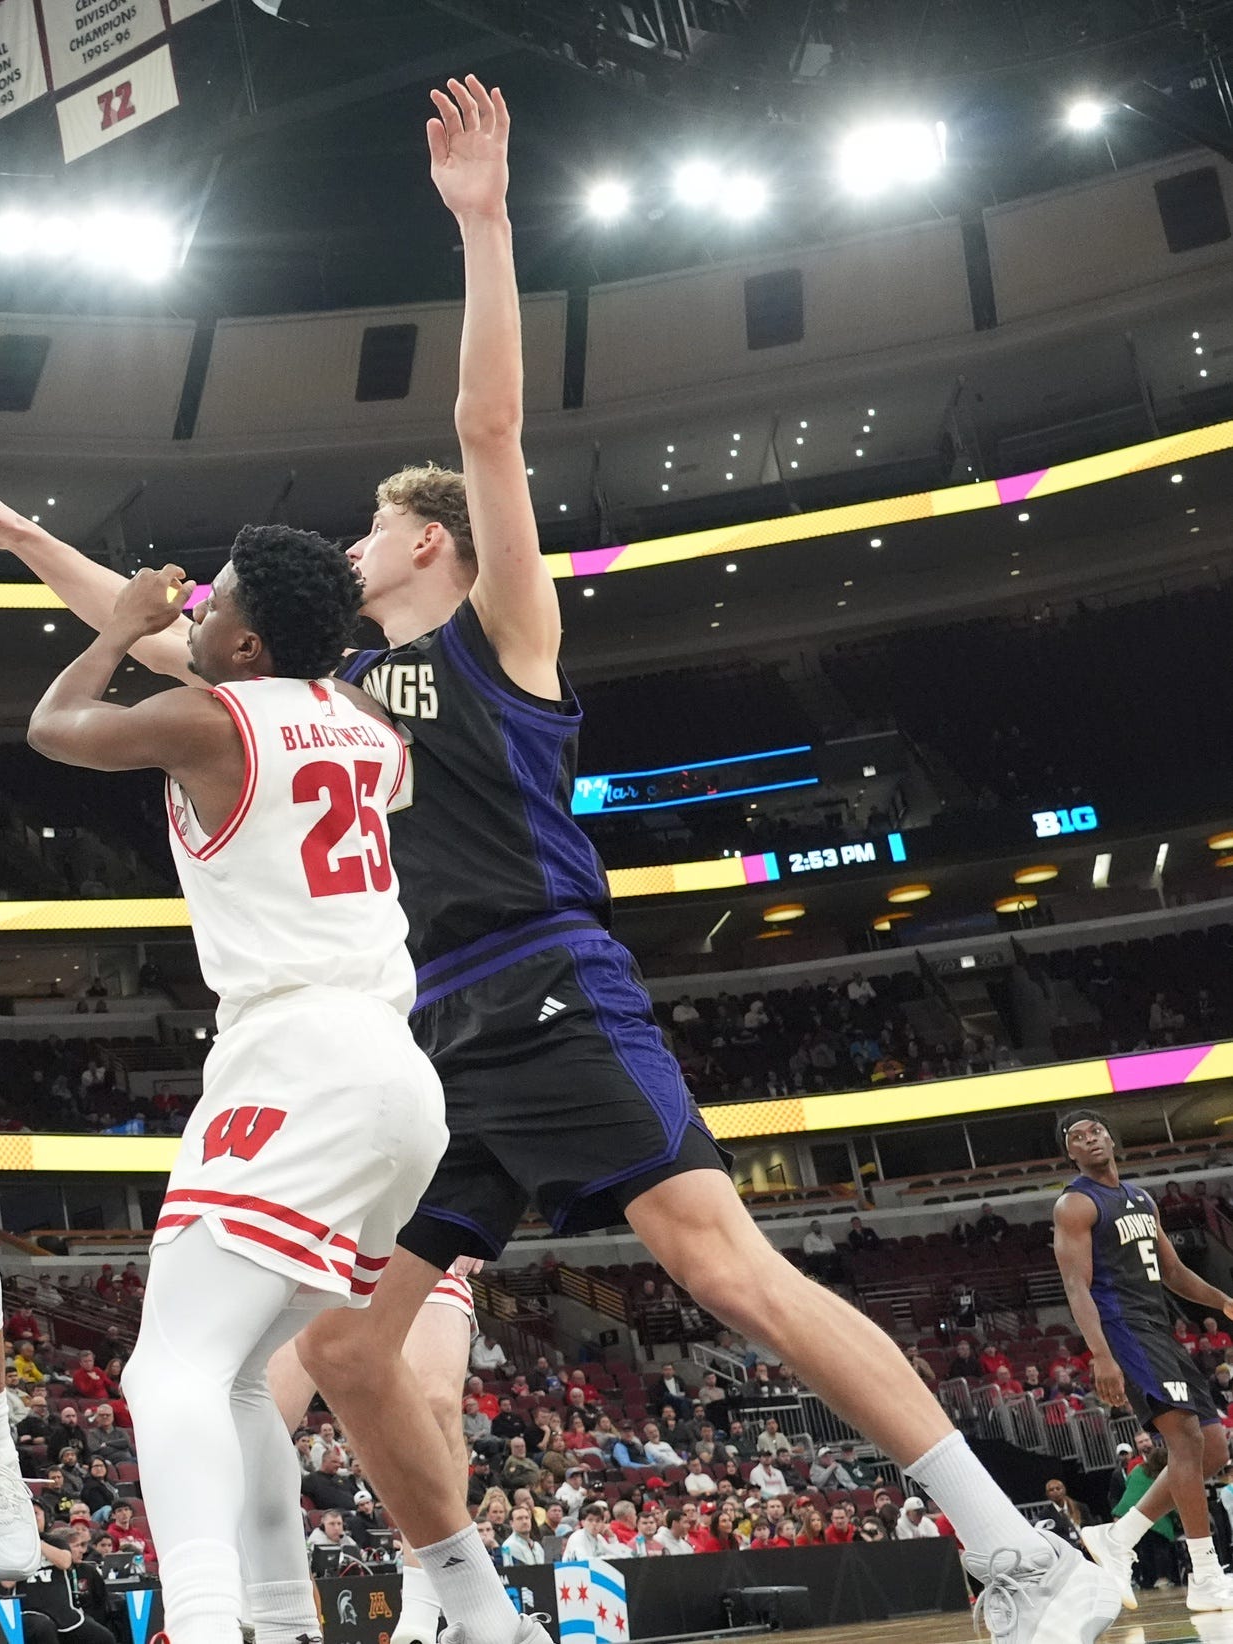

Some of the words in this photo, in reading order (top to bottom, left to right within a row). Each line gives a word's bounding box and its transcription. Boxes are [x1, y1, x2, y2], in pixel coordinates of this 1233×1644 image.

[69, 5, 138, 52] CHAMPIONS
[81, 28, 132, 65] 1995-96
[97, 80, 136, 132] 72
[280, 723, 386, 751] BLACKWELL
[292, 760, 392, 898] 25
[788, 848, 839, 873] 2:53
[840, 842, 876, 865] PM
[202, 1106, 288, 1166] W
[1137, 1240, 1162, 1282] 5
[1163, 1381, 1189, 1402] W
